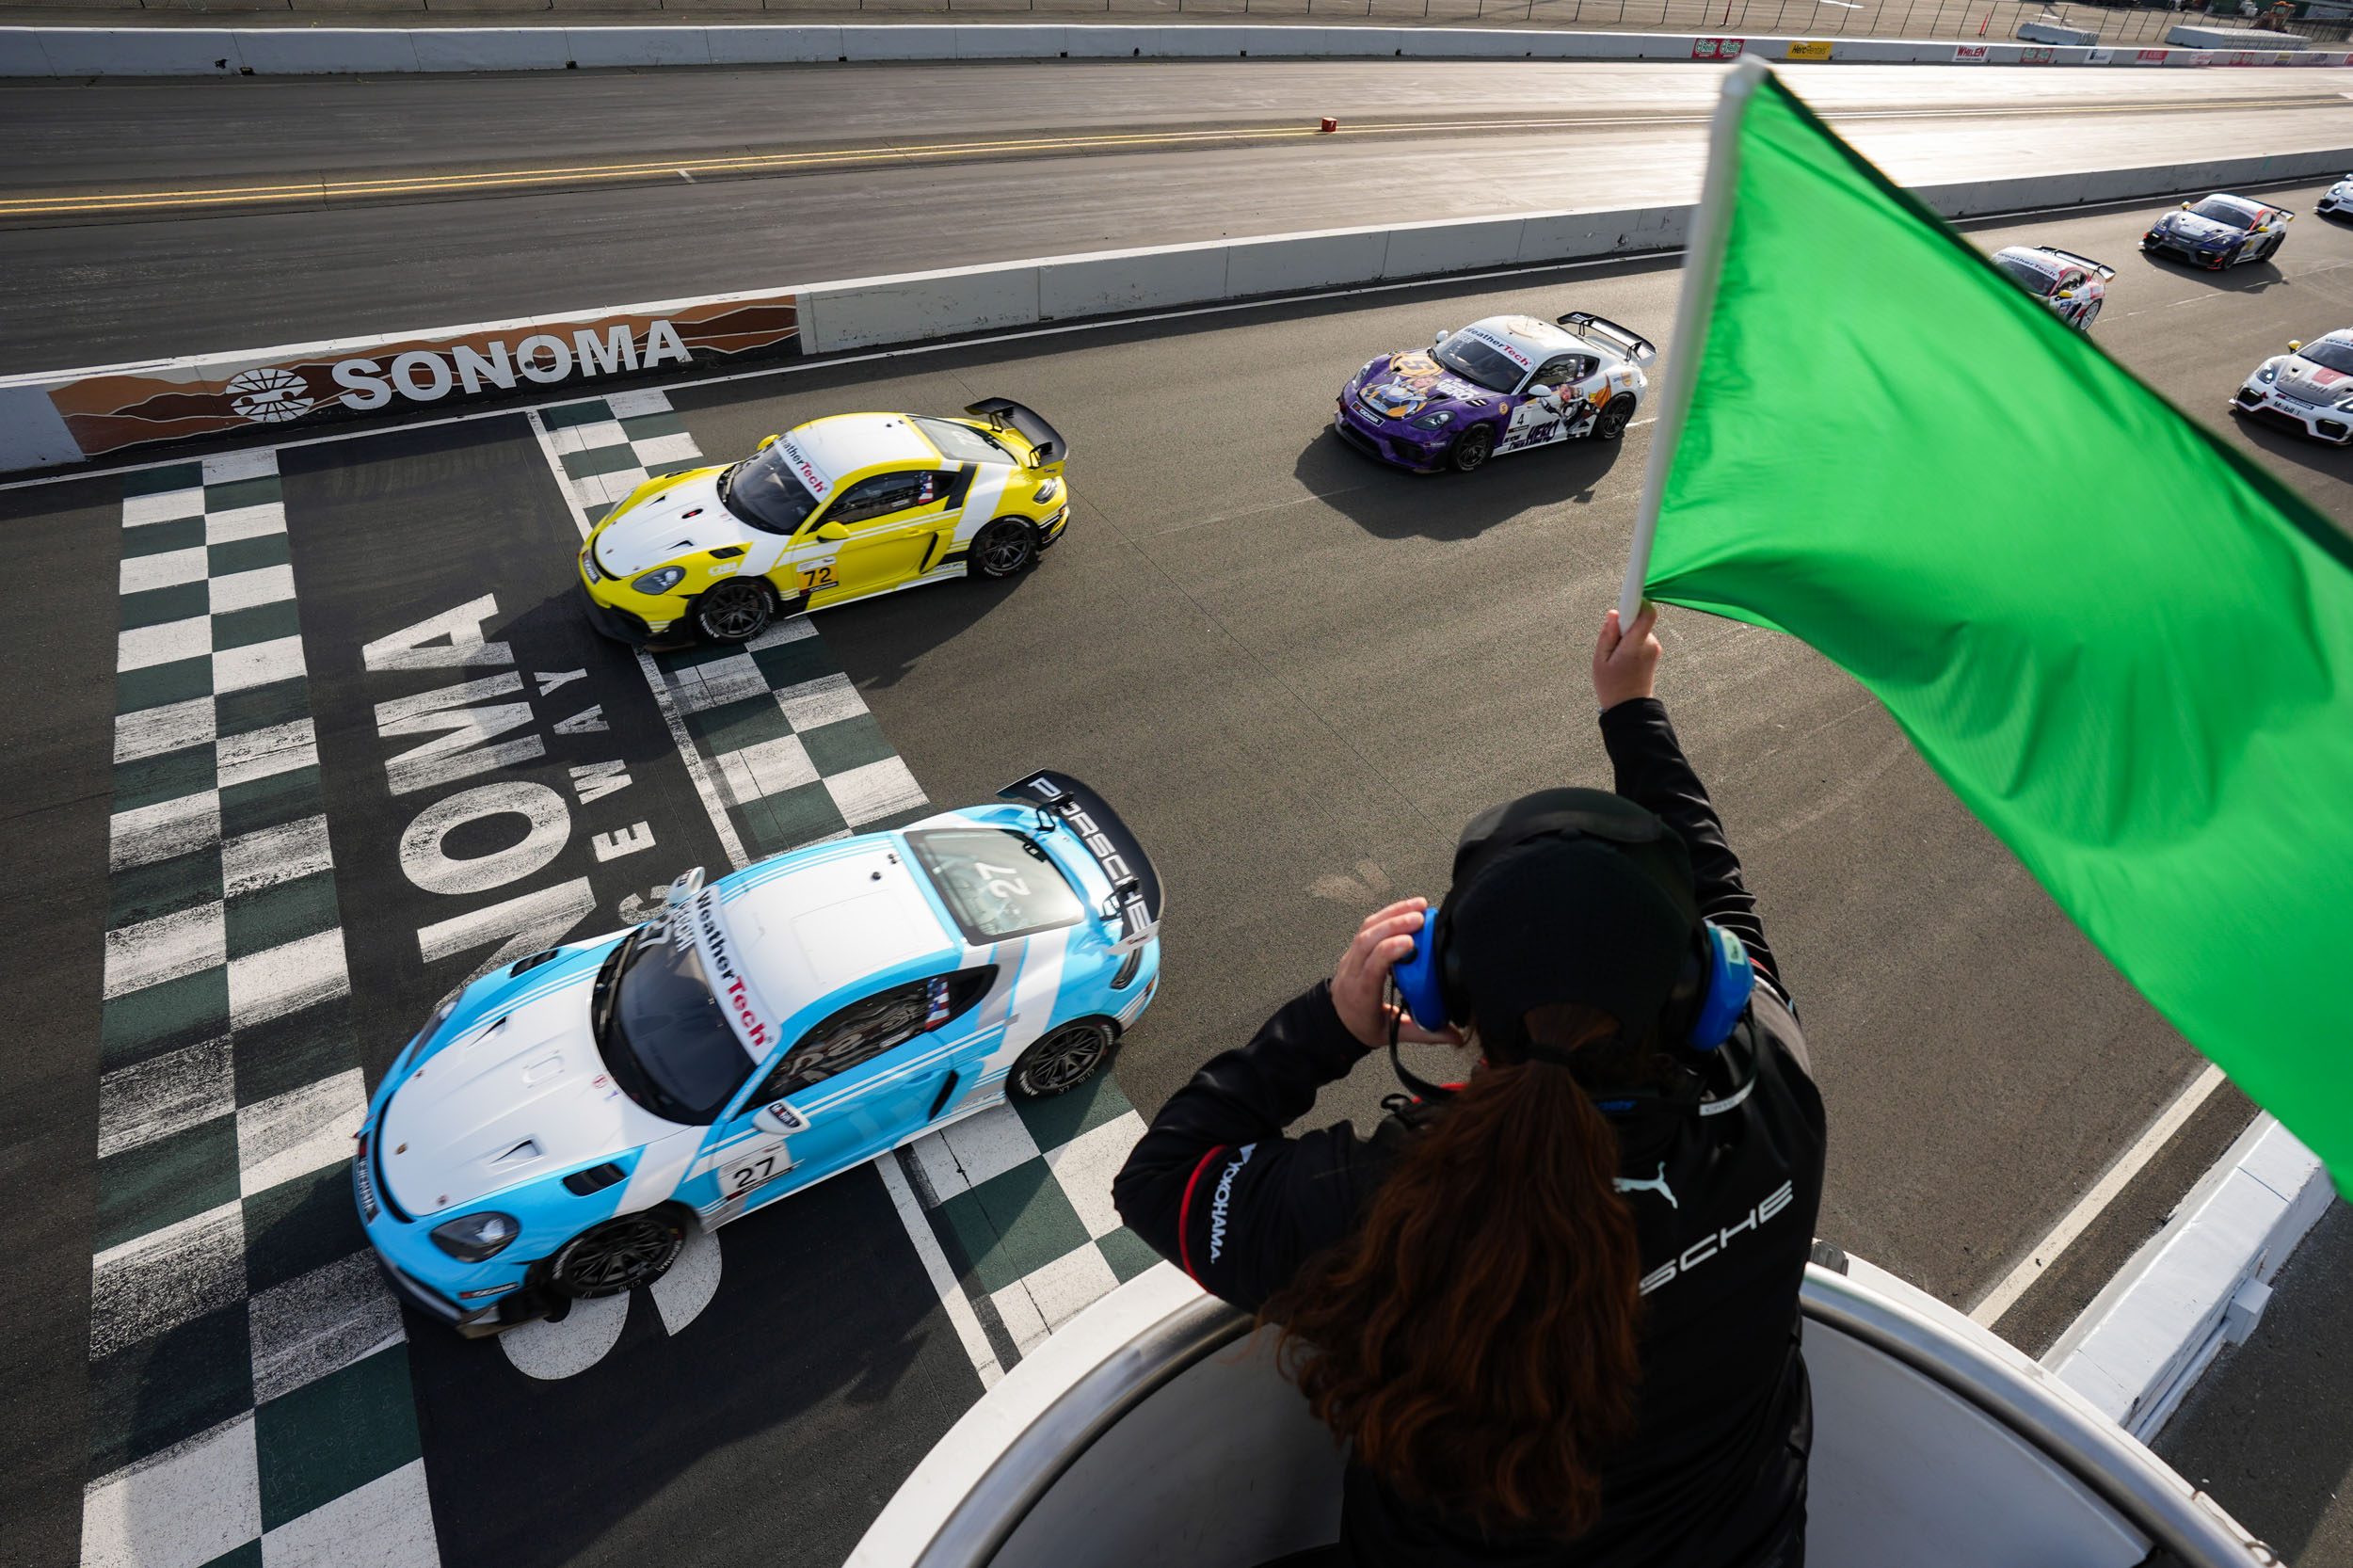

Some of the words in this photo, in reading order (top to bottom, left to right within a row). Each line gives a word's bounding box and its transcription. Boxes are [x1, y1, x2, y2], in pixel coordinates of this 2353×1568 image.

[331, 319, 694, 410] SONOMA
[1517, 414, 1525, 425] 4
[804, 568, 833, 587] 72
[696, 890, 768, 1047] WeatherTech
[733, 1156, 775, 1188] 27
[1210, 1161, 1243, 1264] YOKOHAMA
